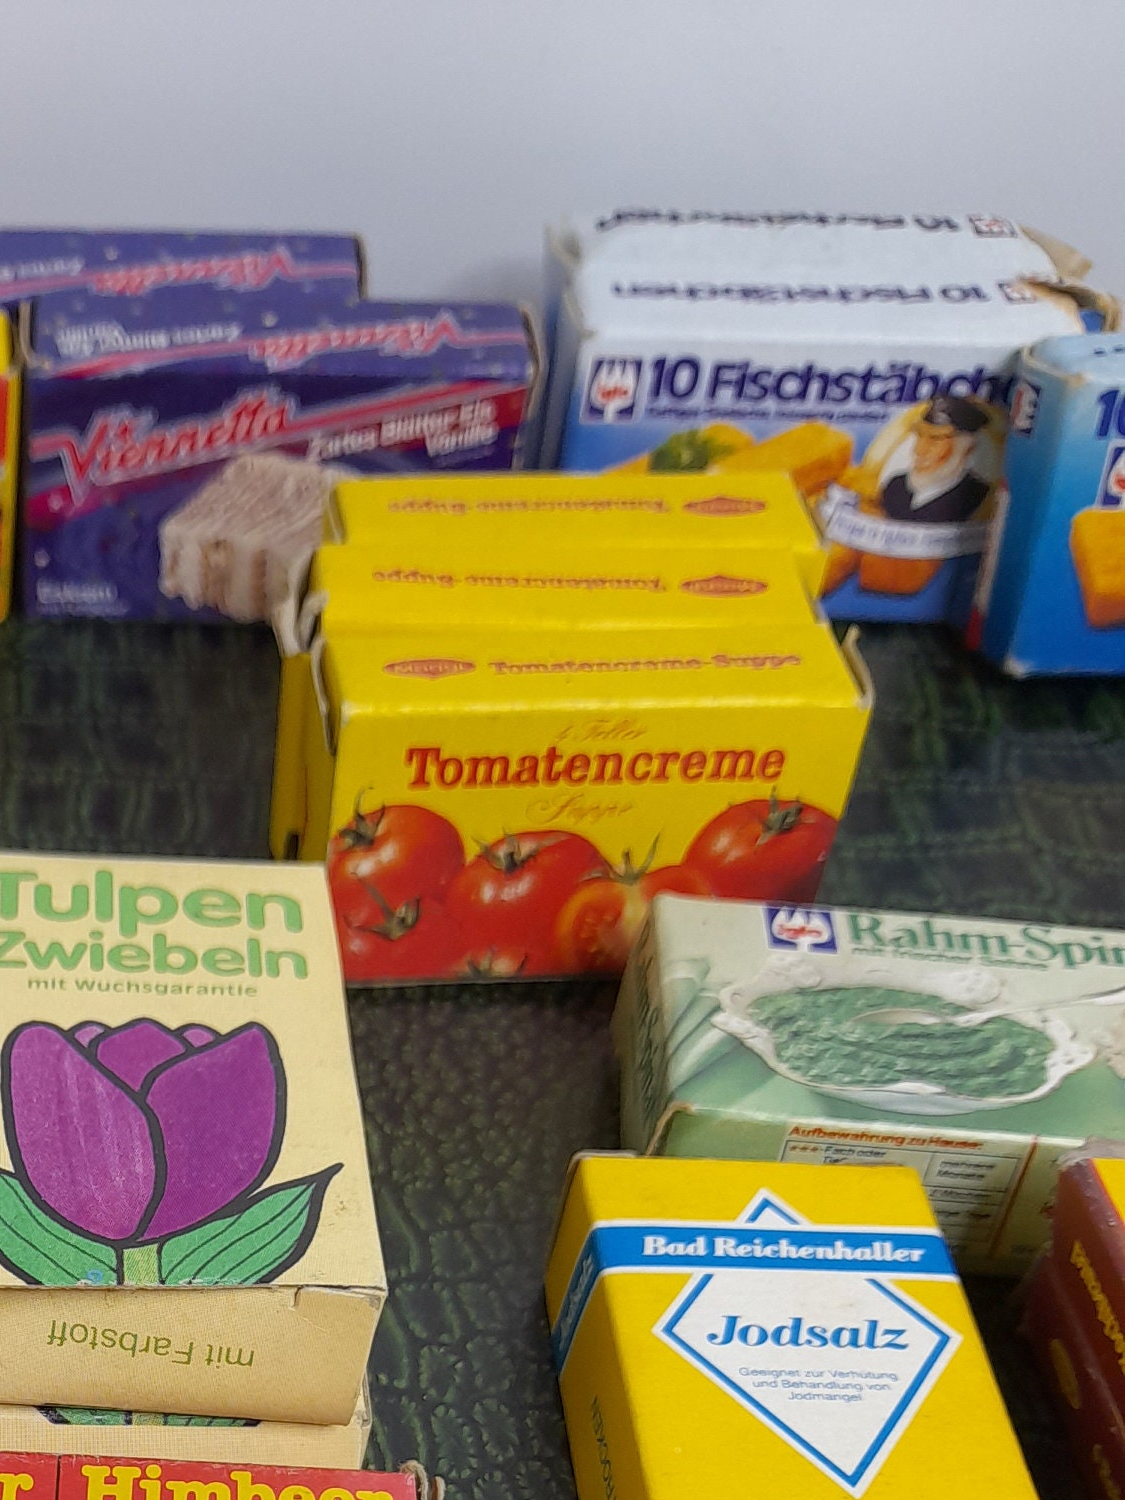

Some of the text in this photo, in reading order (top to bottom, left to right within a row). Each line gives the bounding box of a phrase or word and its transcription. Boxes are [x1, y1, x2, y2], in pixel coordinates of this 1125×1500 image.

[649, 357, 699, 401] 10
[406, 745, 786, 789] Tomatencreme
[27, 976, 258, 998] mit Wuchsgarantie
[642, 1235, 926, 1264] Bad Reichenhaller
[47, 1319, 255, 1370] mit Farbstoff
[706, 1313, 909, 1351] Jodsalz
[752, 1380, 777, 1388] und
[782, 1380, 863, 1392] Behandlung
